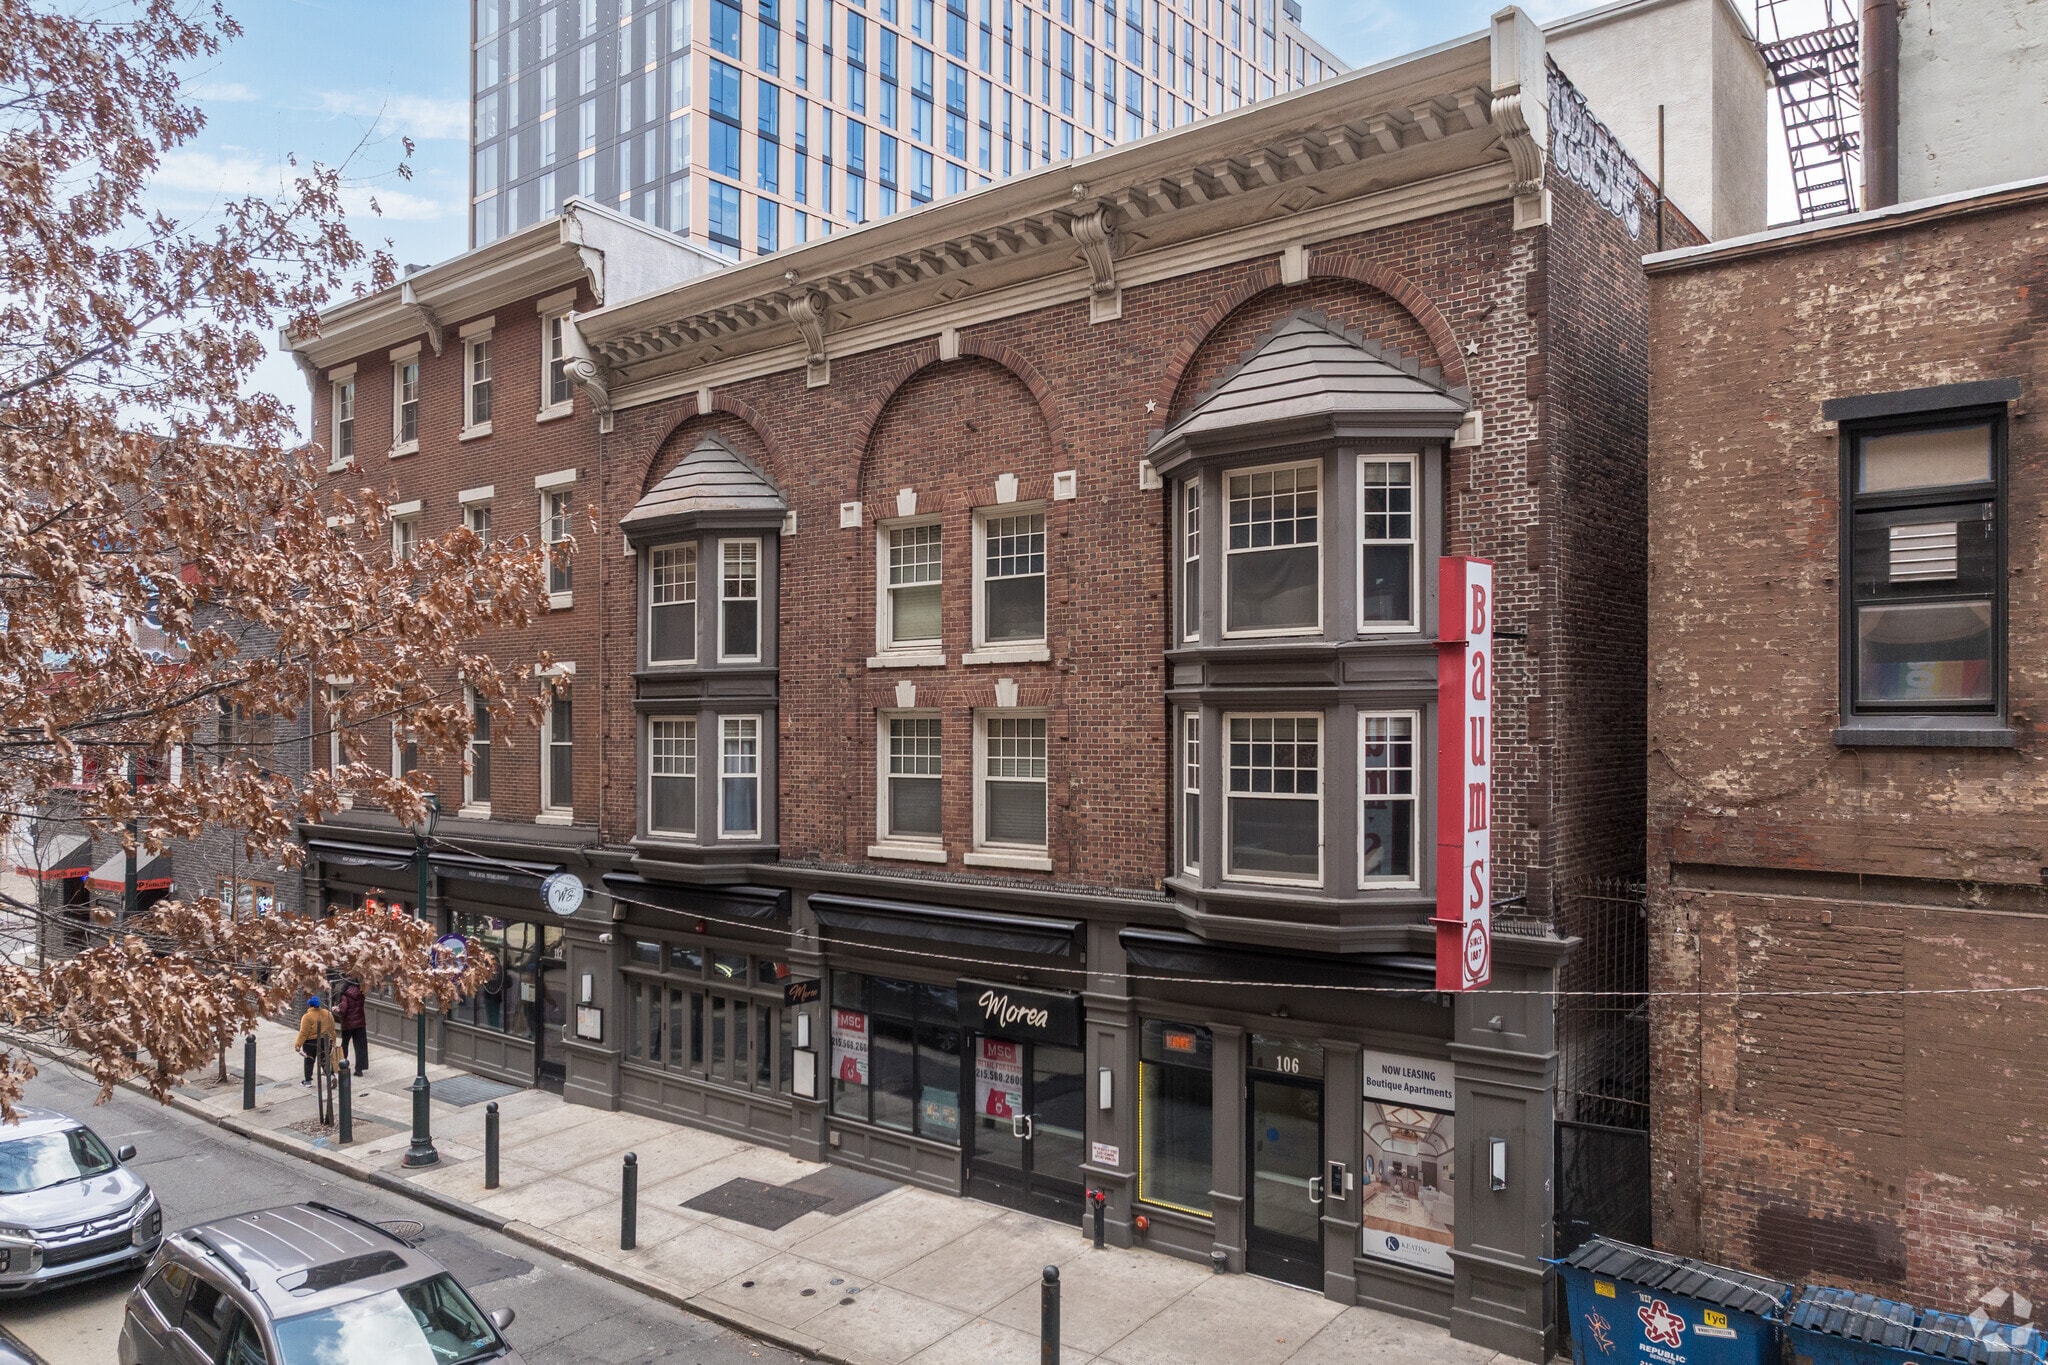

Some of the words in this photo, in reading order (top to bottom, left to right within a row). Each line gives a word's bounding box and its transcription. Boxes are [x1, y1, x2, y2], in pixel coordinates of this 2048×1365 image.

[1469, 936, 1482, 948] SINCE
[978, 989, 1048, 1028] Morea
[841, 1014, 861, 1029] MSC
[988, 1043, 1012, 1059] MSC
[1276, 1055, 1300, 1074] 106
[1381, 1064, 1401, 1077] NOW
[1402, 1067, 1437, 1082] LEASING
[1366, 1076, 1403, 1092] Boutique
[1403, 1082, 1453, 1099] Apartments
[1401, 1241, 1431, 1255] KEATING
[1706, 1312, 1726, 1325] 1yd
[1639, 1342, 1687, 1363] REPUBLIC
[1649, 1353, 1676, 1365] SERVICES
